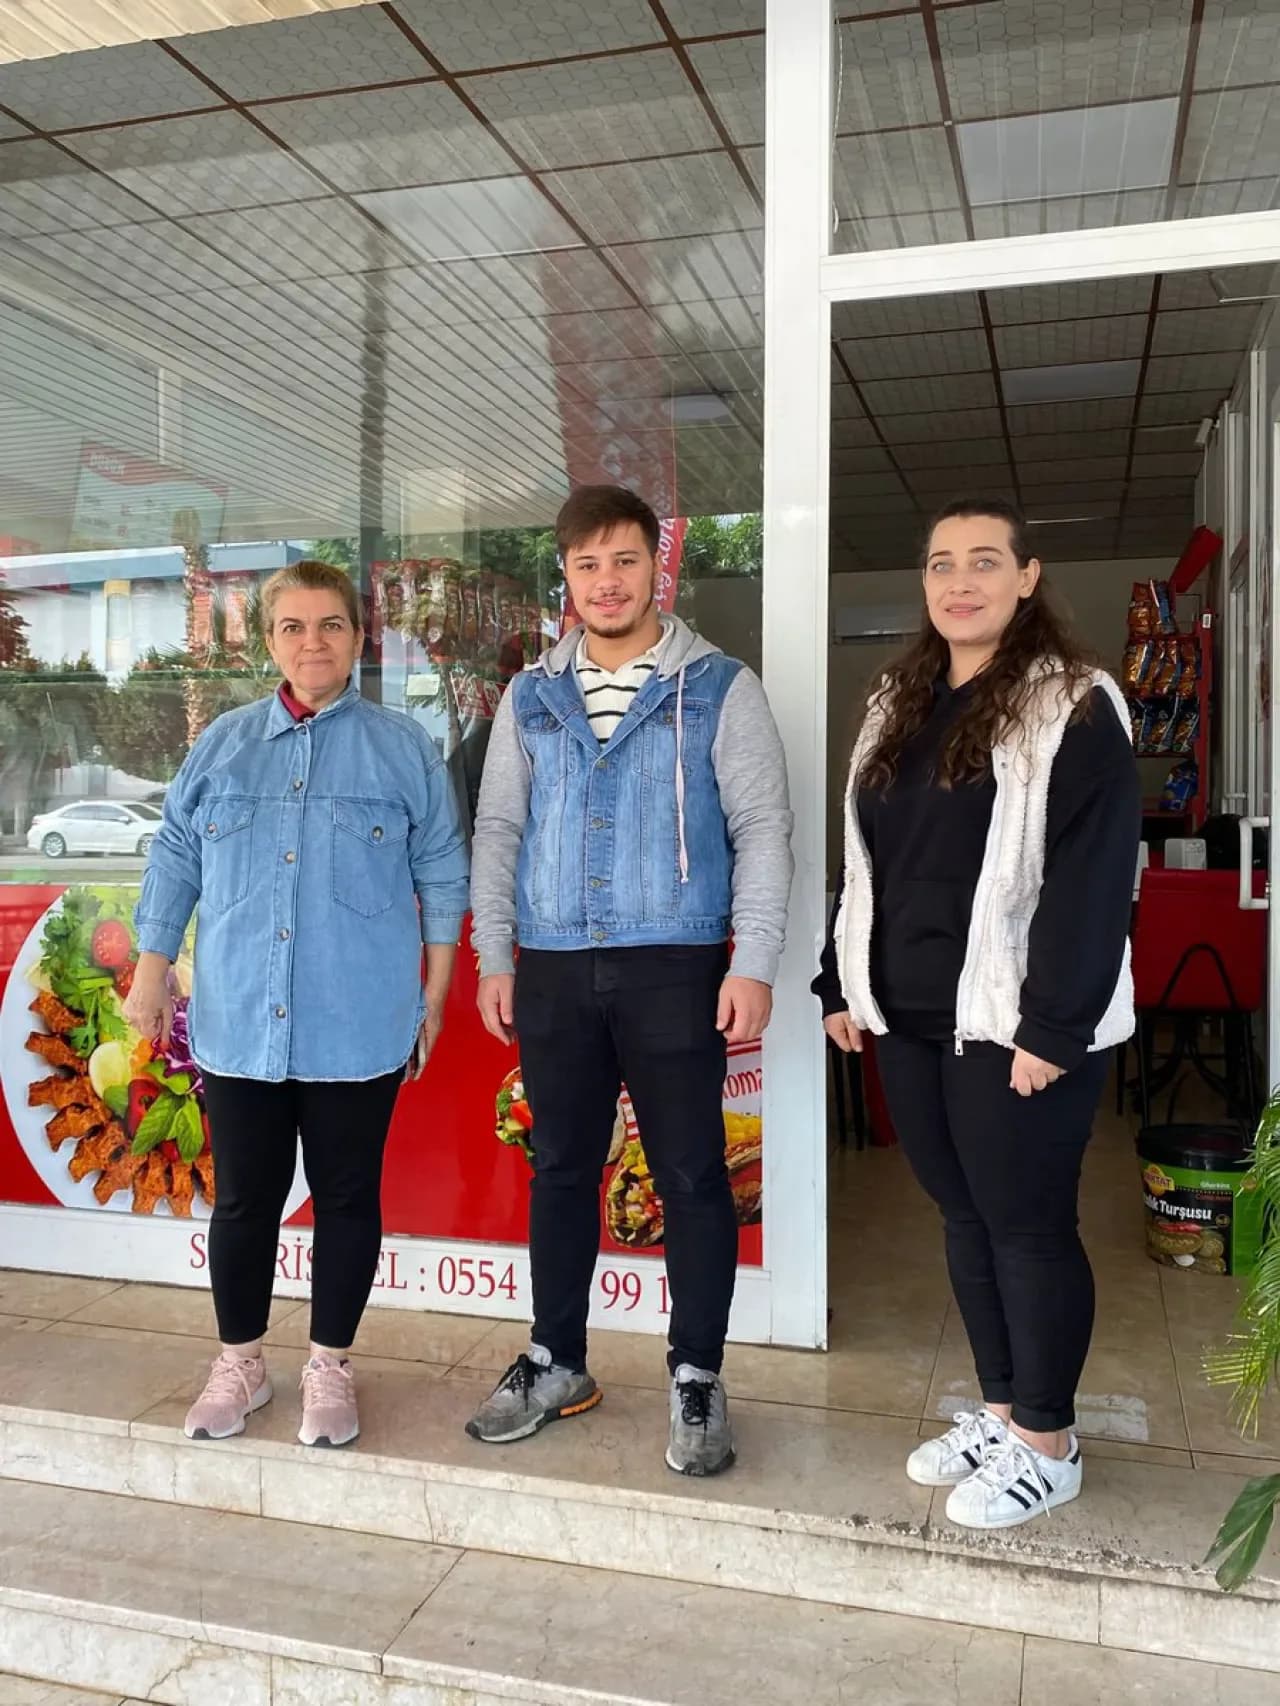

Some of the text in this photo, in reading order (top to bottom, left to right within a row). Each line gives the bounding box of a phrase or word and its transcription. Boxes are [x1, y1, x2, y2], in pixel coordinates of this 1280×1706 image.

[1159, 1199, 1212, 1221] Turşusu
[371, 1250, 408, 1290] EL
[437, 1255, 518, 1301] 0554
[600, 1269, 642, 1312] 99
